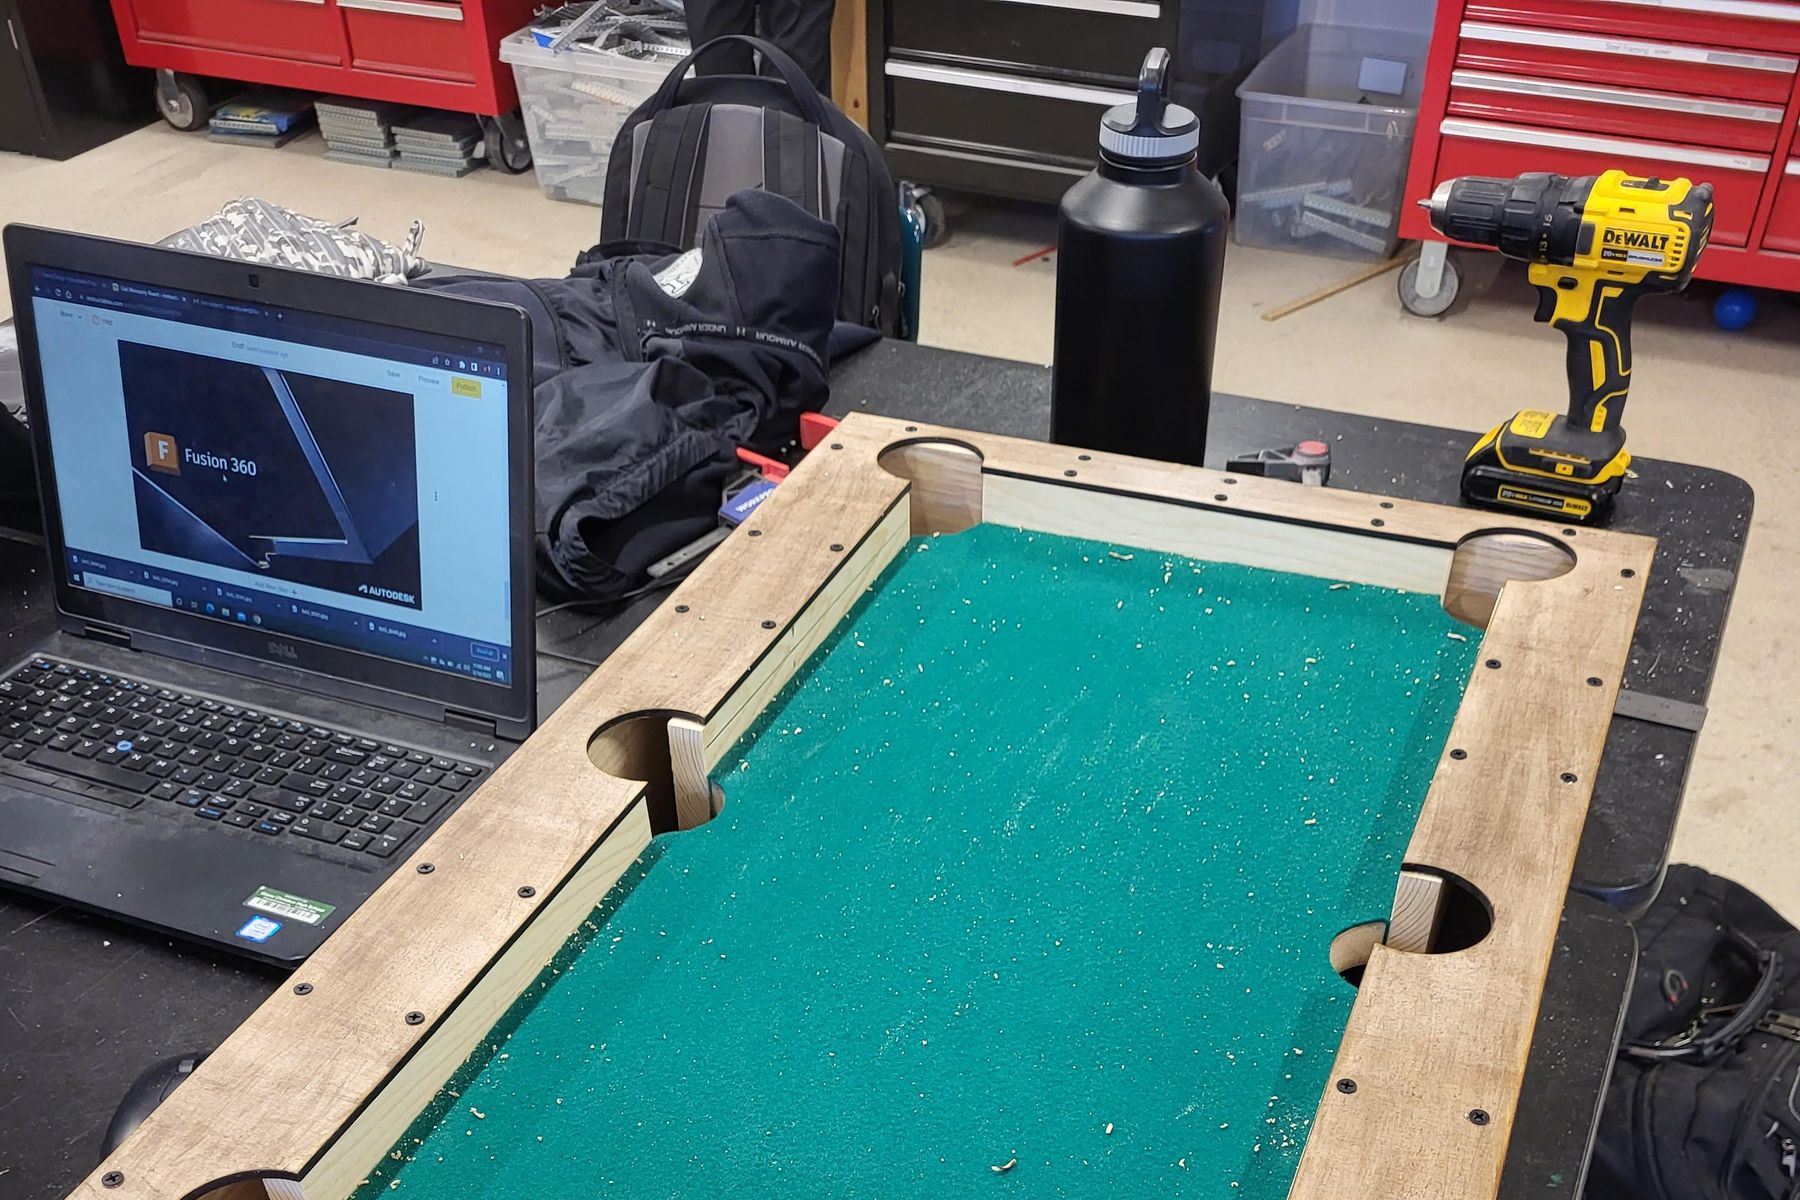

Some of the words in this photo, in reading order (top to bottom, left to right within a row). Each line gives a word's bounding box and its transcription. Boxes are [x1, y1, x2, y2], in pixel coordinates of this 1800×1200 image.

[1602, 229, 1670, 250] DEWALT
[698, 323, 727, 334] UNDER
[755, 331, 798, 348] ARMOUR
[185, 448, 228, 470] Fusion
[230, 457, 257, 476] 360
[368, 586, 416, 604] AUTODESK
